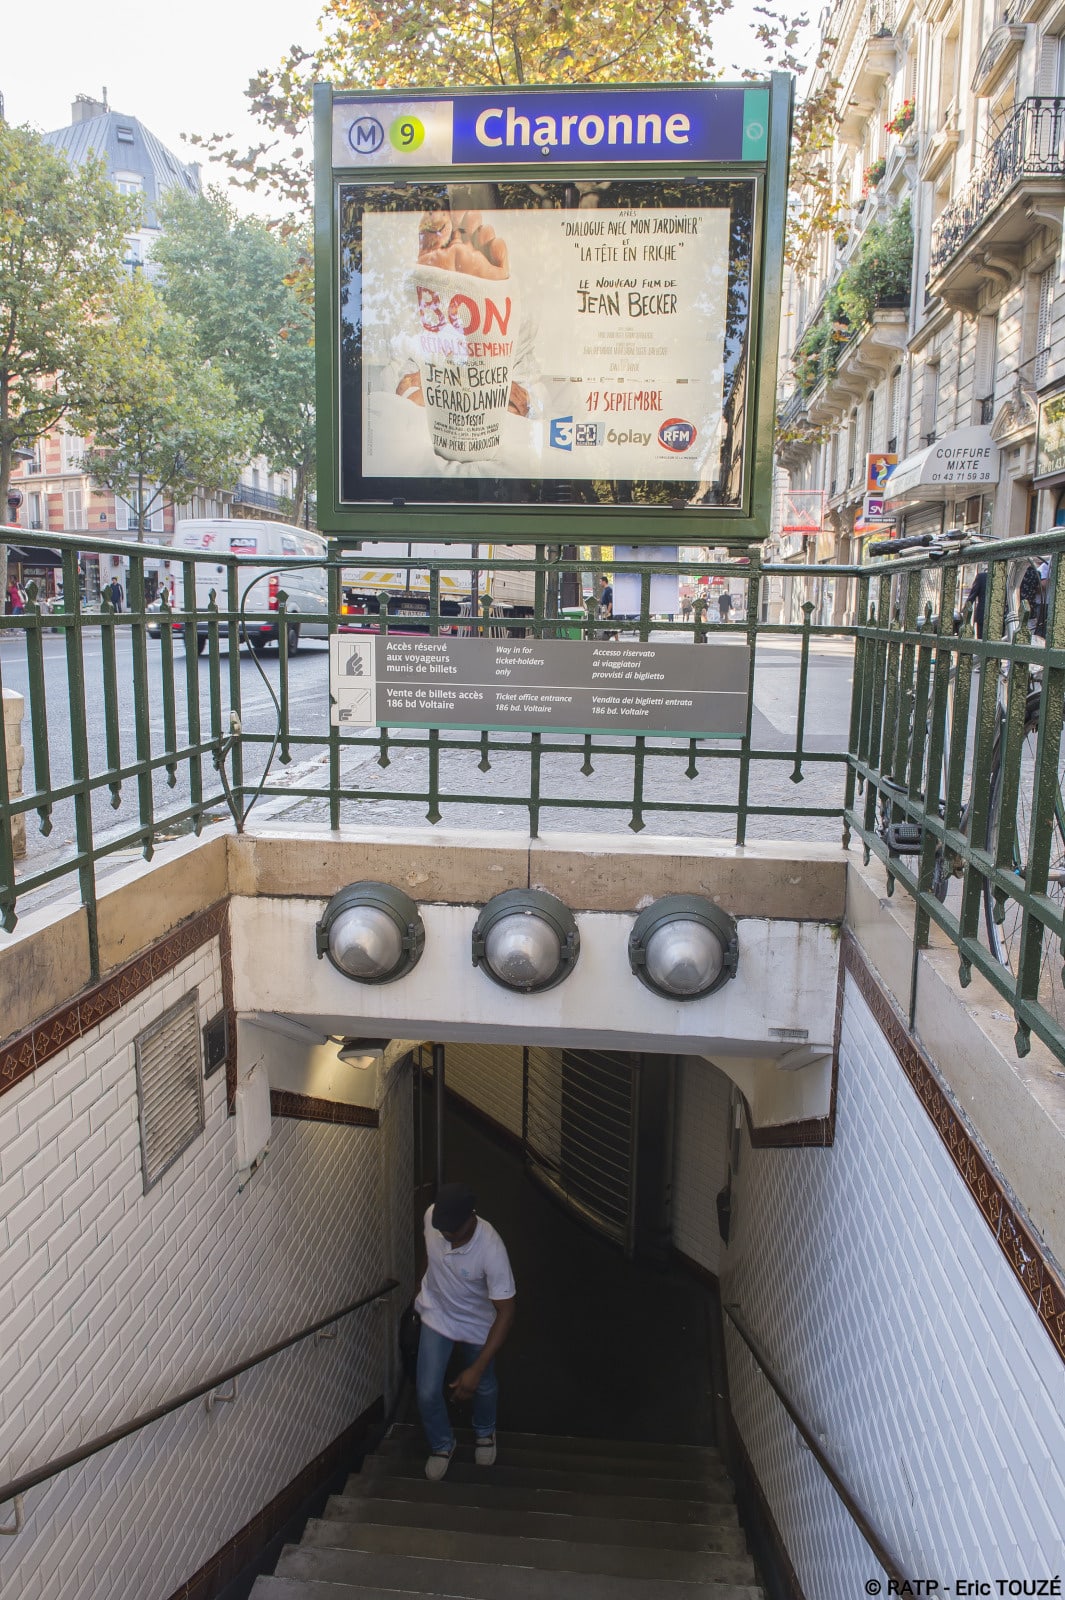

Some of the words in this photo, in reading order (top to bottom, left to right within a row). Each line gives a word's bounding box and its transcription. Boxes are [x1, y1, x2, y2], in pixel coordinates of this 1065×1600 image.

[475, 106, 691, 147] Charonne
[400, 123, 415, 146] 9
[608, 221, 626, 236] AVEC
[630, 219, 650, 234] MON
[623, 246, 637, 261] EN
[579, 279, 590, 289] LE
[596, 277, 637, 288] NOUVEAU
[642, 279, 661, 288] FILM
[664, 279, 677, 288] DE
[577, 290, 621, 316] JEAN
[628, 291, 677, 317] BECKER
[416, 286, 512, 336] BON
[425, 362, 462, 386] JEAN
[468, 366, 508, 387] BECKER
[426, 385, 471, 413] GÉRARD
[473, 385, 508, 410] LANVIN
[586, 391, 599, 412] 17
[603, 390, 664, 412] SEPTEMBRE
[554, 422, 573, 446] 3
[576, 424, 597, 442] 20
[607, 429, 652, 446] 6play
[663, 430, 690, 442] RFM
[936, 448, 990, 459] COIFFURE
[947, 460, 979, 470] MIXTE
[386, 641, 412, 651] Accès
[414, 641, 447, 652] réservé
[496, 646, 511, 654] Way
[514, 646, 520, 654] in
[522, 646, 533, 655] for
[593, 648, 621, 657] Accesso
[622, 649, 655, 658] riservato
[386, 654, 402, 662] aux
[404, 655, 450, 664] voyageurs
[495, 657, 544, 666] ticket-holders
[601, 660, 641, 669] viaggiatori
[386, 664, 413, 672] munis
[415, 664, 427, 673] de
[429, 665, 457, 674] billets
[495, 668, 511, 677] only
[592, 671, 623, 680] provvisti
[625, 671, 632, 679] di
[634, 672, 664, 681] biglietto
[387, 688, 413, 698] Vente
[415, 689, 427, 698] de
[429, 689, 456, 699] billets
[459, 690, 483, 700] accès
[496, 692, 517, 701] Ticket
[518, 693, 539, 702] office
[386, 699, 403, 708] 186
[405, 699, 417, 708] bd
[419, 700, 455, 709] Voltaire
[592, 695, 620, 704] Vendita
[622, 696, 633, 705] dei
[635, 697, 664, 706] biglietti
[523, 704, 552, 713] Voltaire
[607, 707, 618, 715] bd.
[620, 708, 649, 716] Voltaire
